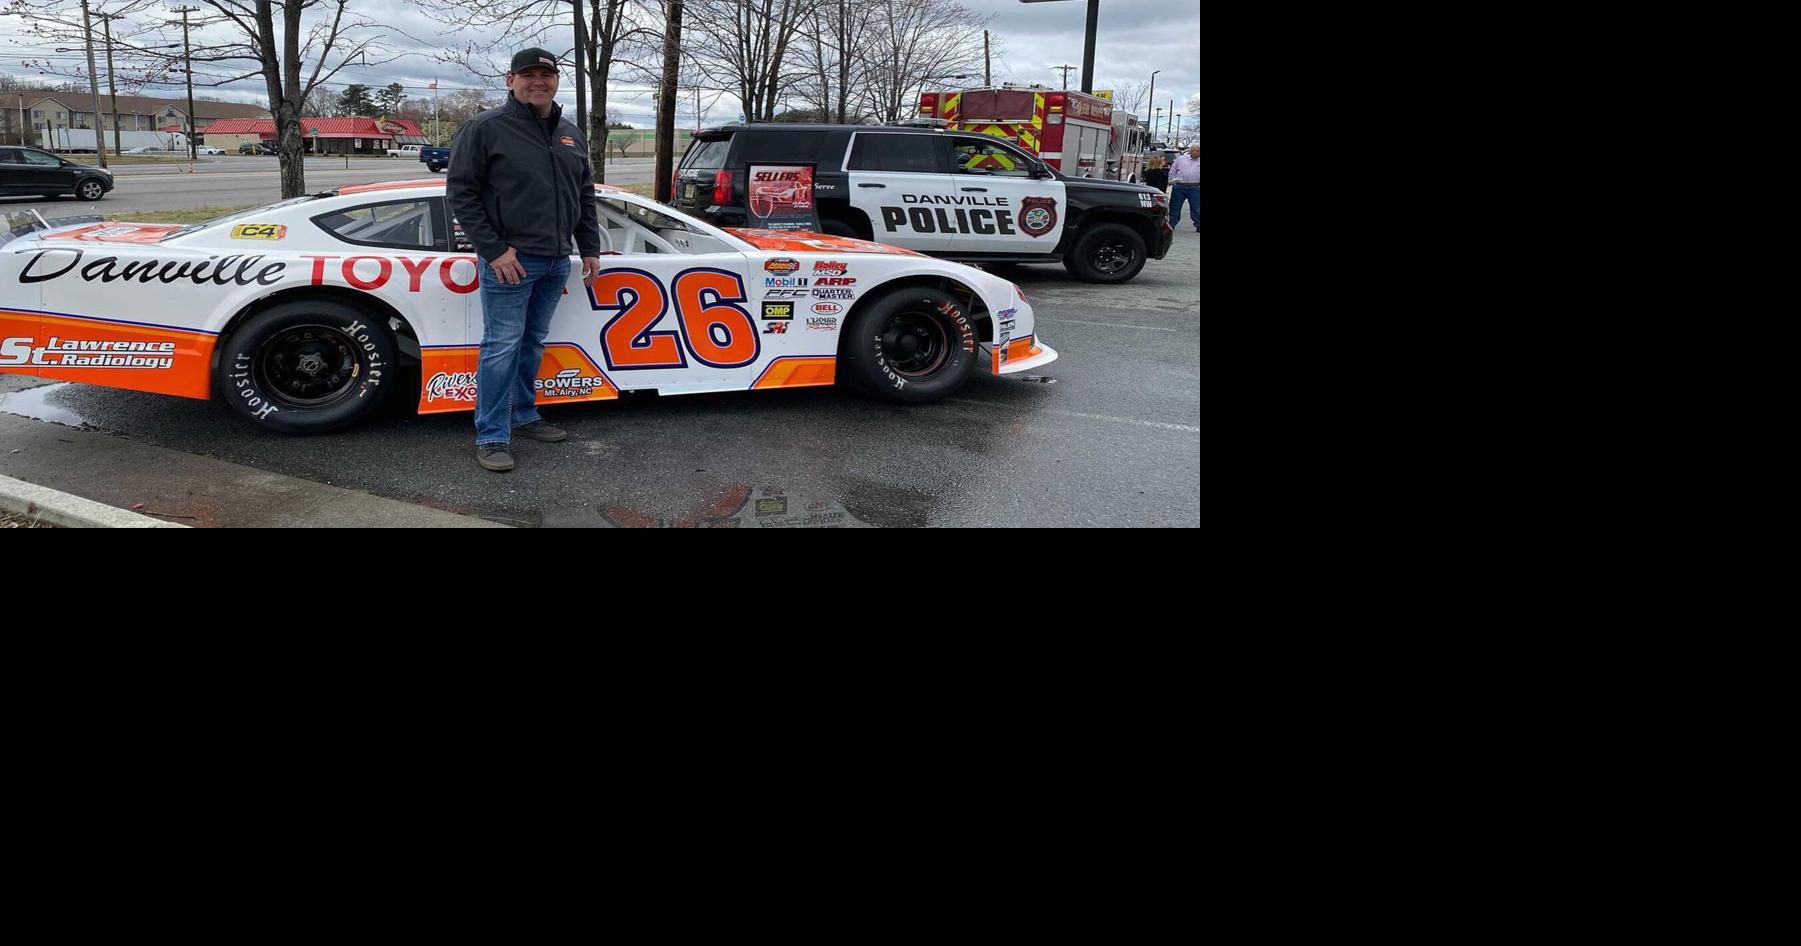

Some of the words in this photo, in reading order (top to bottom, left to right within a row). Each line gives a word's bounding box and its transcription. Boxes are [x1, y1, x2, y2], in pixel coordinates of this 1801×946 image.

[902, 194, 1009, 206] DANVILLE
[1140, 200, 1152, 208] NW
[880, 206, 1017, 235] POLICE
[241, 226, 275, 237] C4
[15, 247, 287, 286] Danville
[299, 255, 480, 294] TOYO
[813, 260, 848, 270] Holley
[765, 277, 795, 286] Mobil
[813, 277, 857, 286] ARP
[583, 266, 761, 371] 26
[765, 307, 790, 315] OMP
[938, 301, 974, 352] Hoosier
[0, 337, 58, 366] St.
[47, 337, 176, 352] Lawrence
[341, 320, 387, 386] Hoosier
[59, 353, 174, 369] Radiology
[874, 335, 909, 390] Hoosier
[229, 353, 279, 420] Hoosier
[427, 372, 478, 402] Rivers
[534, 376, 603, 390] SOWERS
[445, 385, 477, 400] EXXO
[560, 389, 578, 398] Airy,
[579, 388, 592, 396] NC
